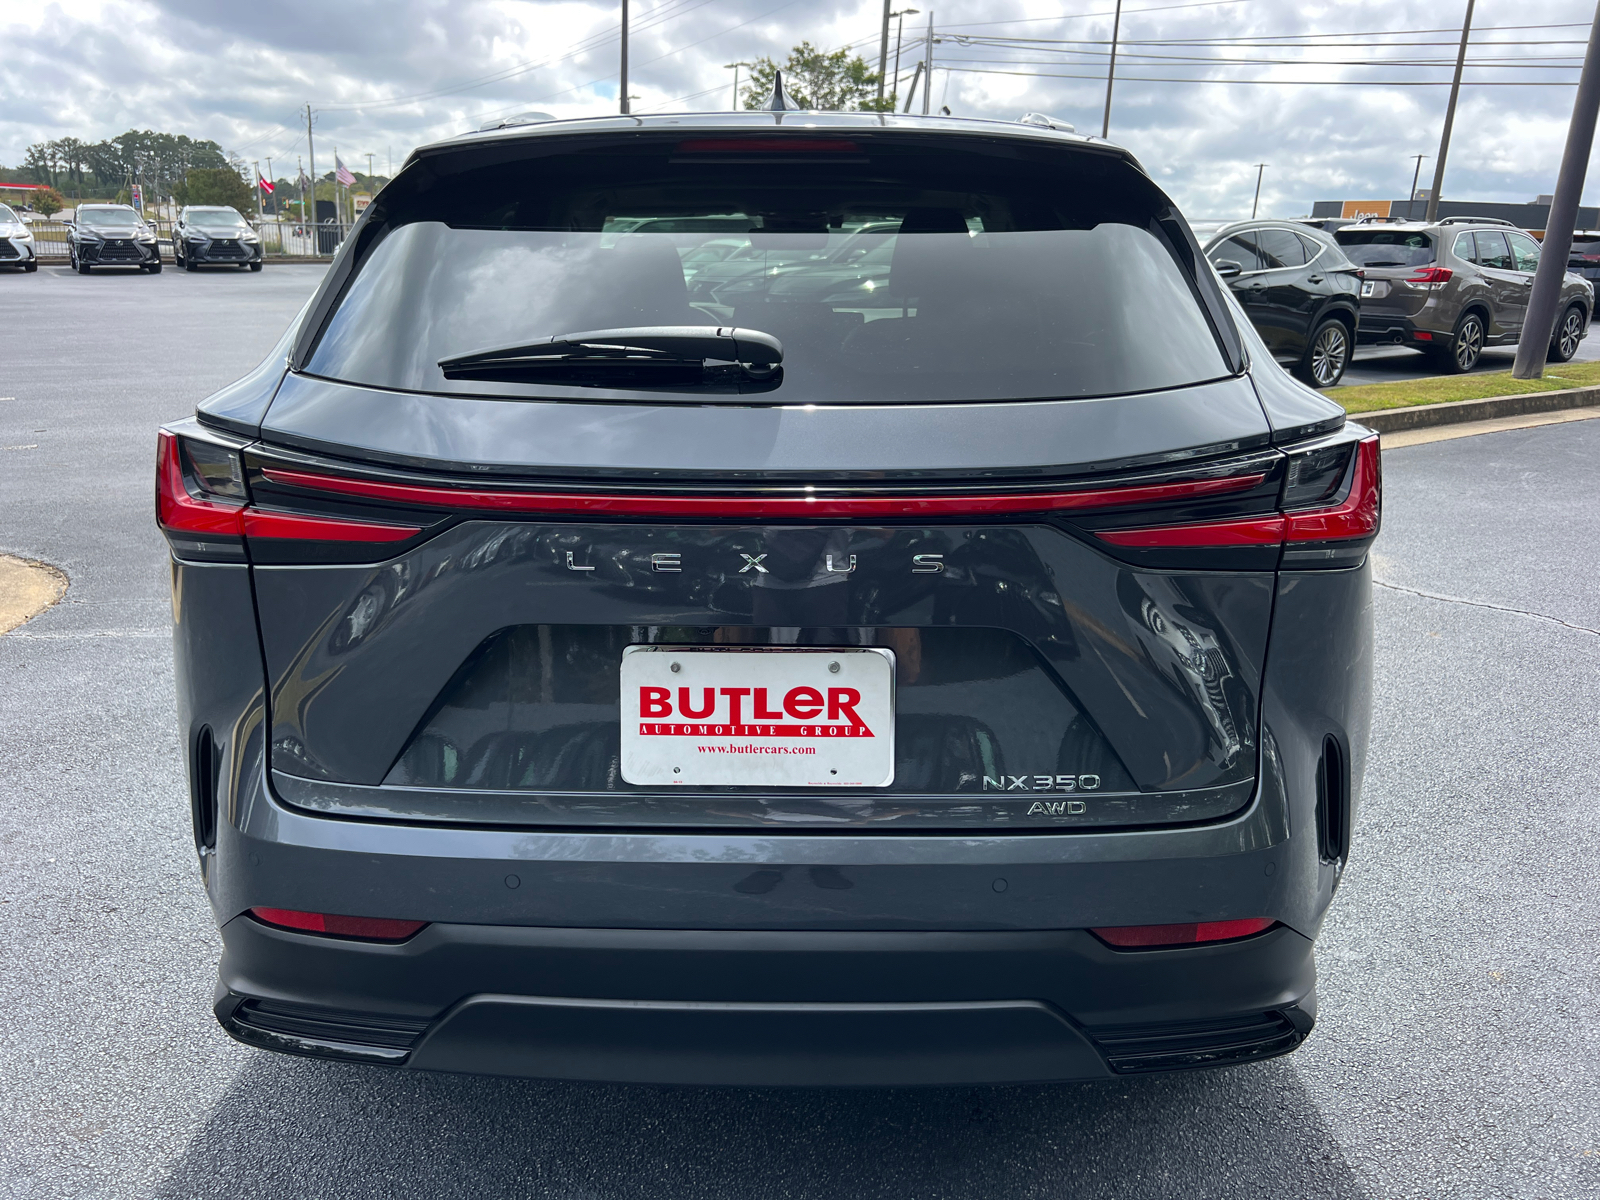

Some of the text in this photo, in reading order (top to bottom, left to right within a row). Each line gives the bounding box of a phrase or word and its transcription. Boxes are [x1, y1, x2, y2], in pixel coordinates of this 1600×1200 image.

[566, 551, 945, 574] LEXUS
[640, 724, 867, 737] AUTOMOTIVE GROUP
[697, 744, 817, 756] www.butlercars.com
[1027, 801, 1087, 816] AWD
